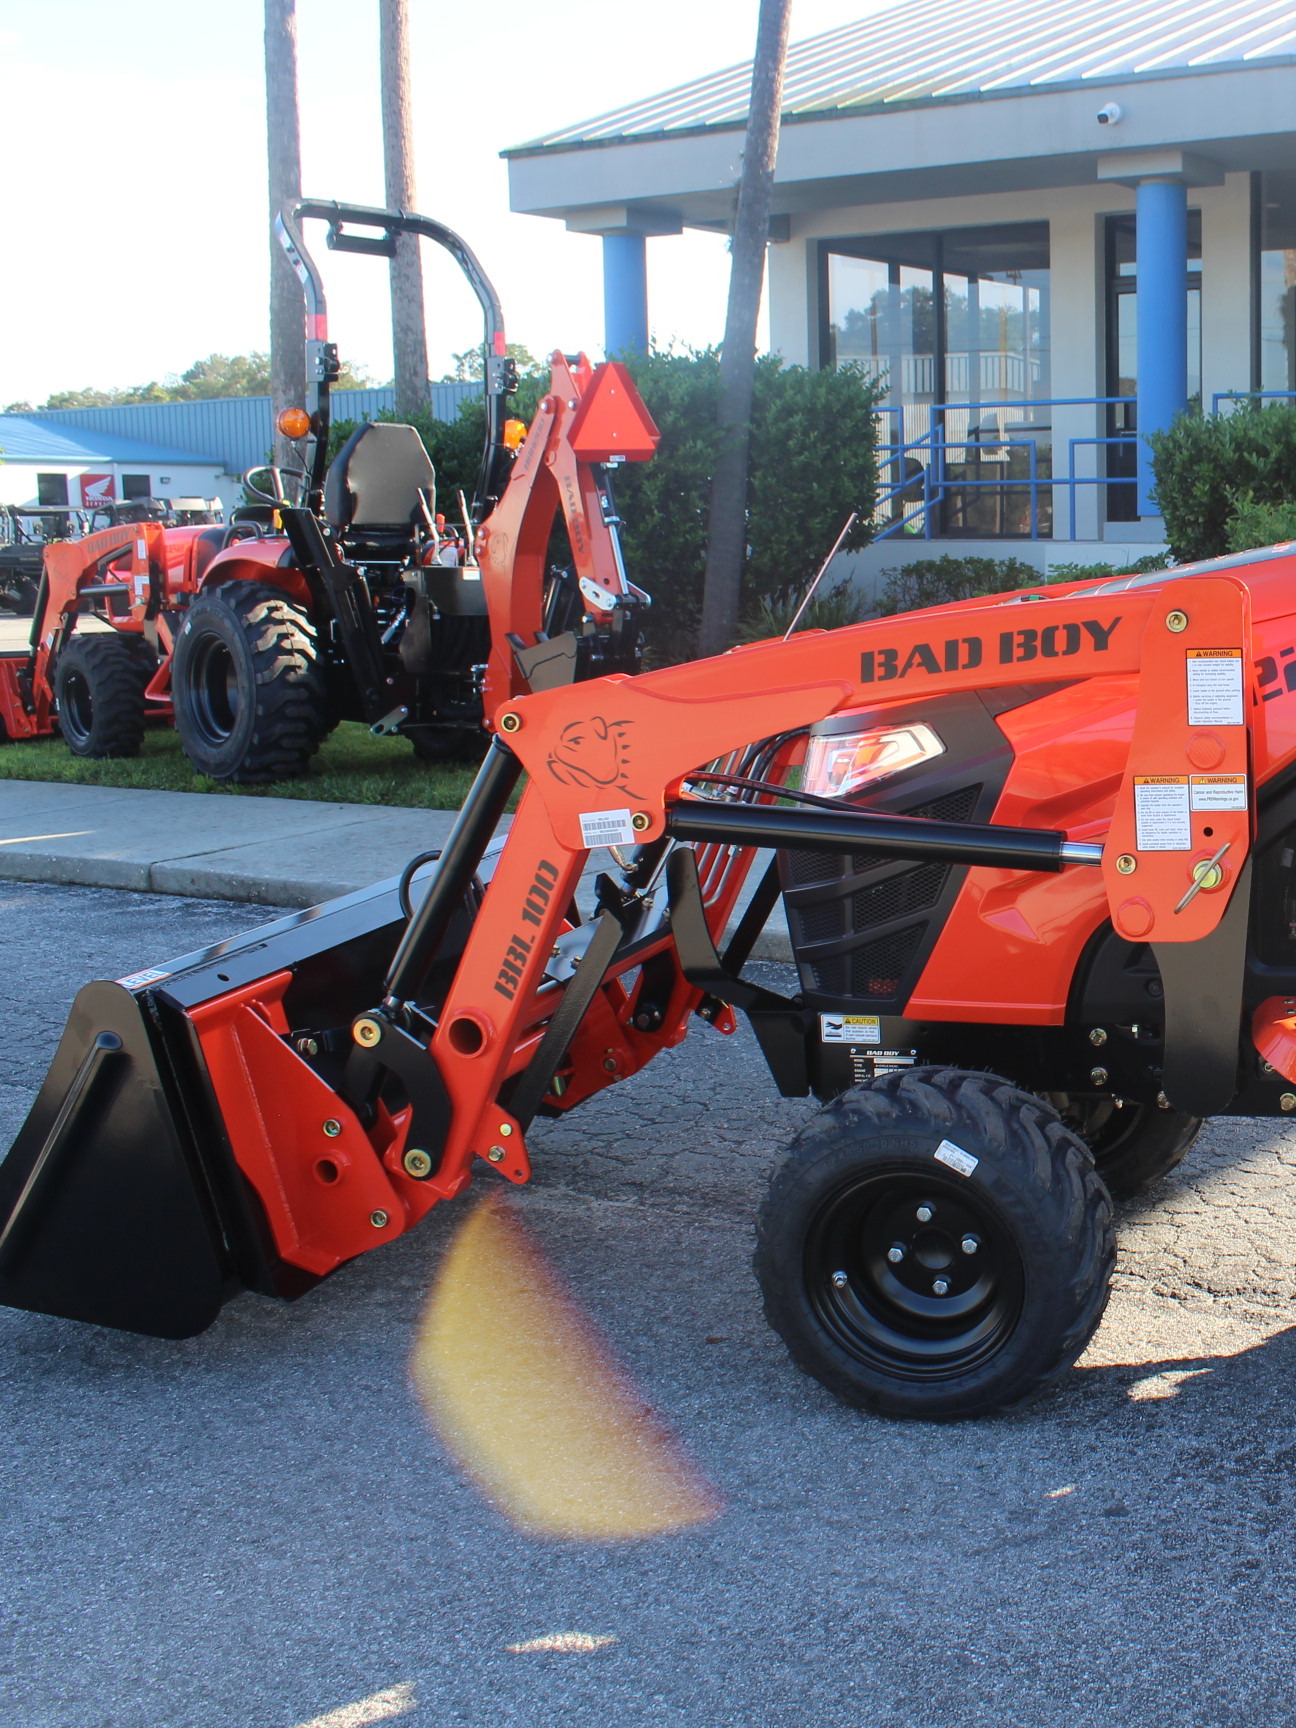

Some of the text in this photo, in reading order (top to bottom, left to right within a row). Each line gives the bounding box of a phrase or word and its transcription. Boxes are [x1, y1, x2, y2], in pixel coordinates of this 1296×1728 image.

[861, 616, 1123, 684] BAD BOY
[521, 859, 559, 927] 100
[121, 970, 167, 988] LEVEL
